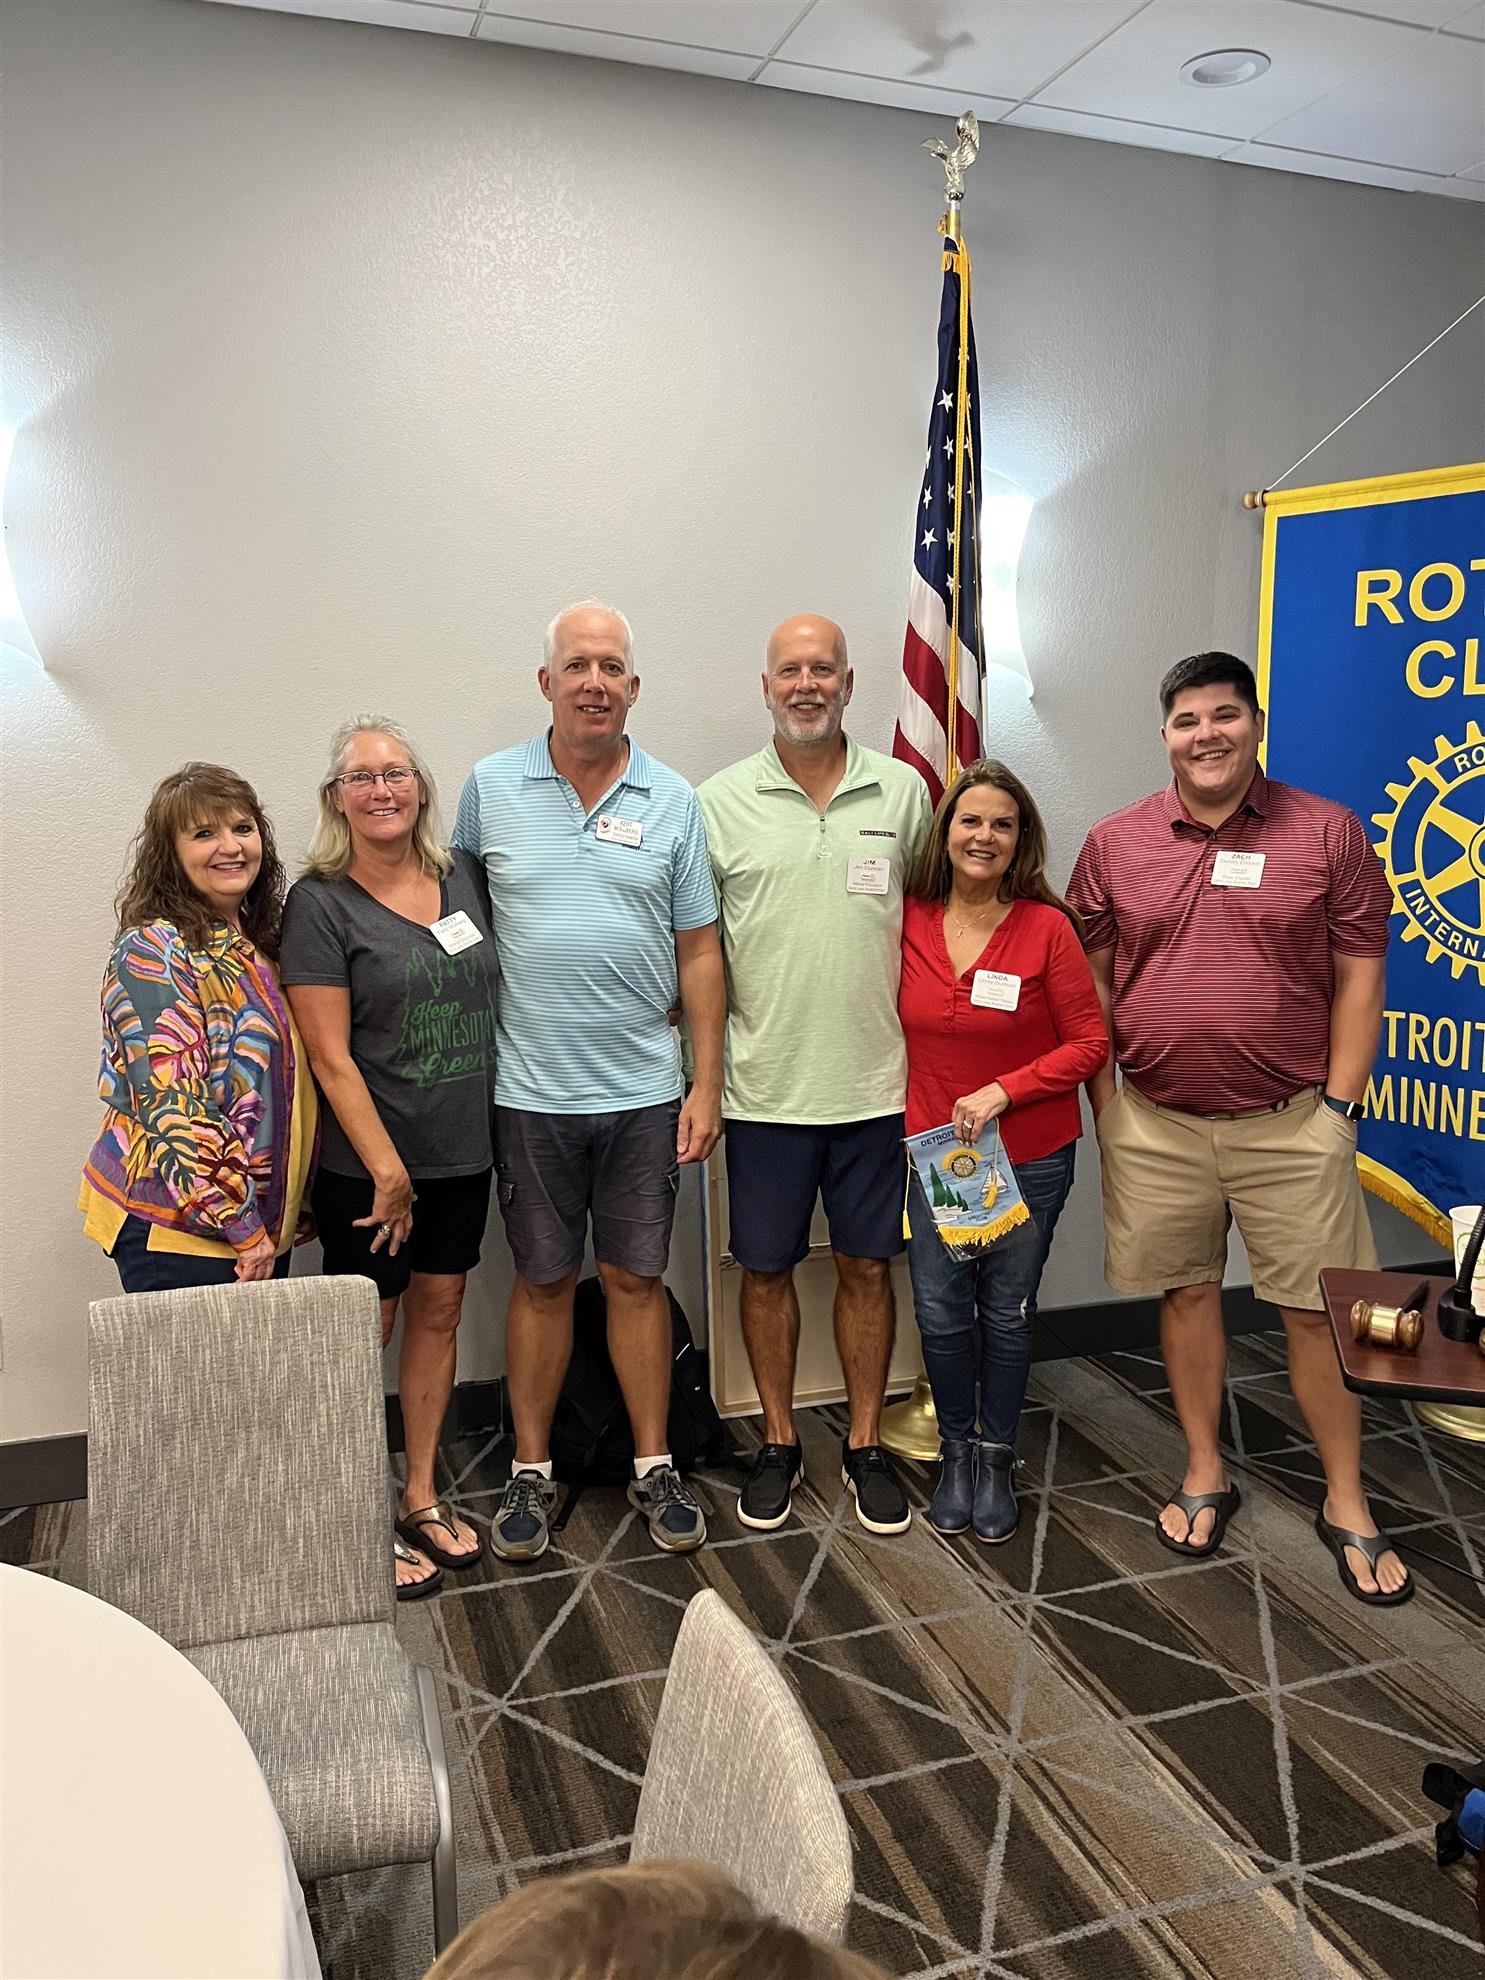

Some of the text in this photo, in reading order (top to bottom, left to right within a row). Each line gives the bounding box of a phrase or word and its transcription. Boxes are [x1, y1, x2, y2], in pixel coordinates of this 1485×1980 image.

[1405, 638, 1485, 698] CL
[1454, 746, 1485, 772] RO
[439, 916, 457, 928] PATTY
[1405, 888, 1485, 959] INTERN
[987, 973, 1009, 982] LINDA
[920, 1130, 955, 1147] DETROIT
